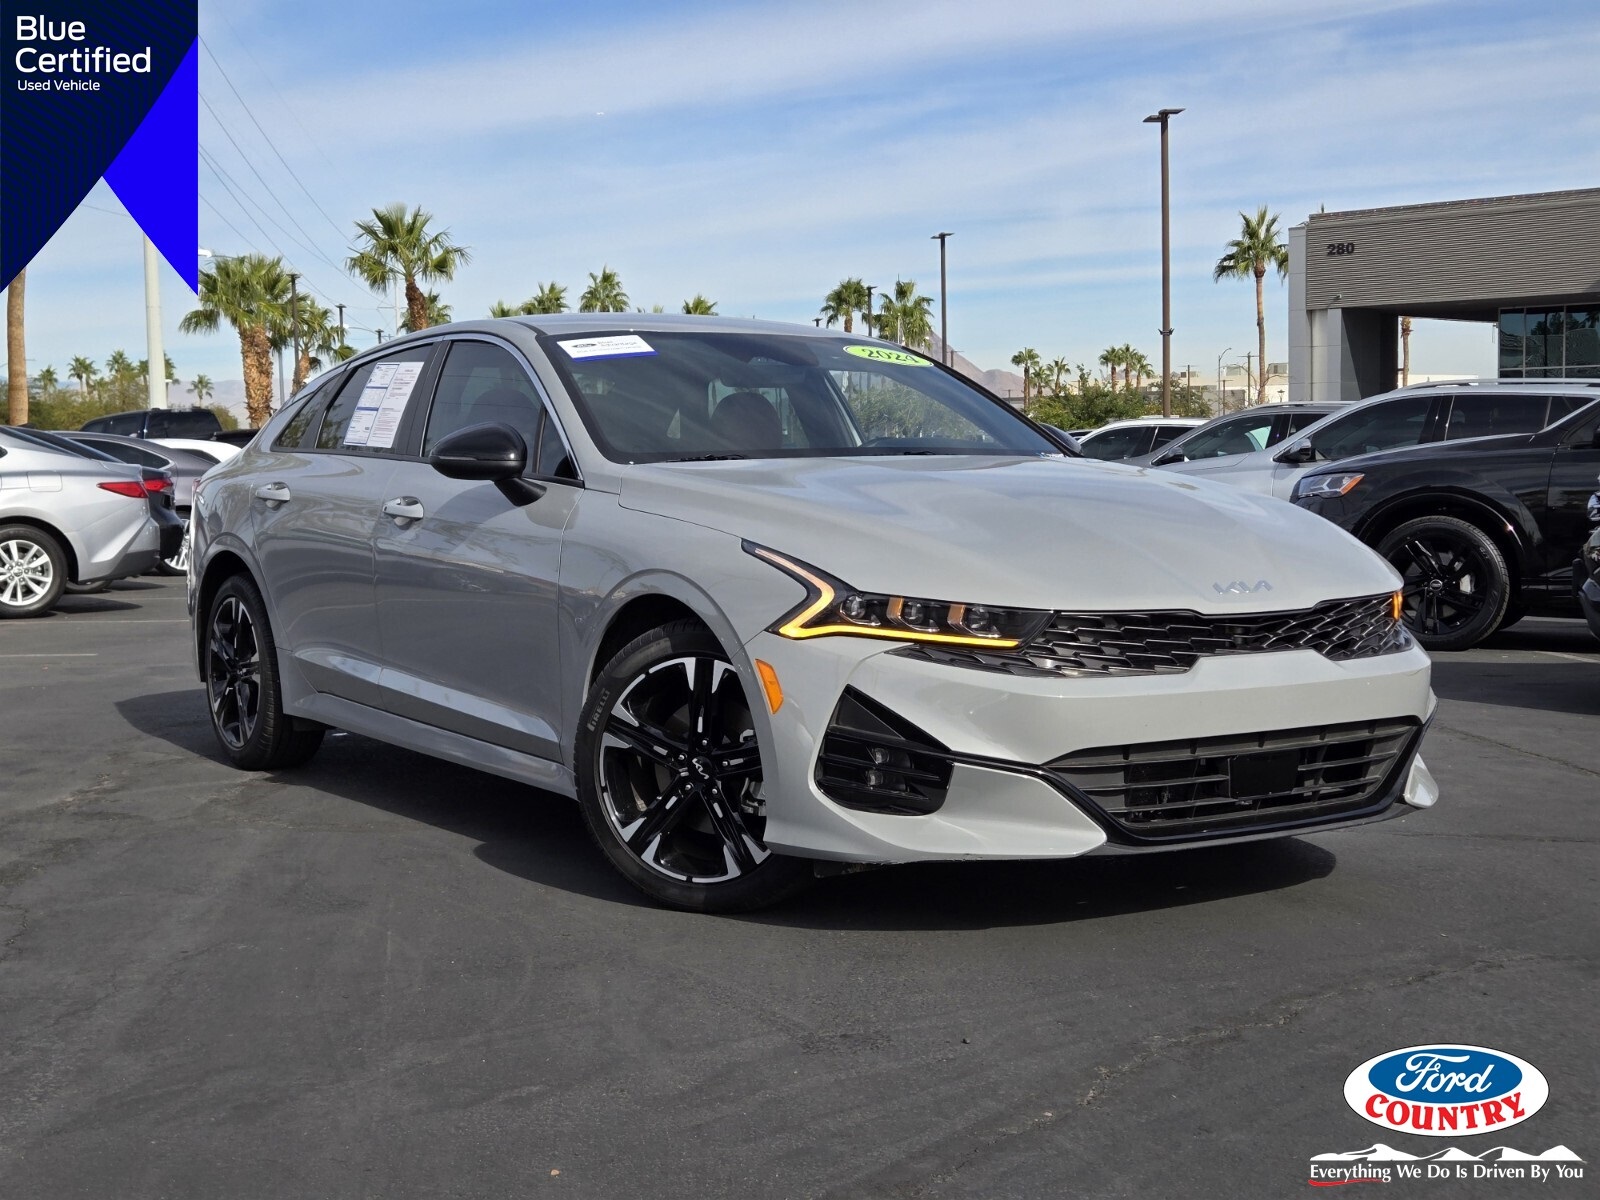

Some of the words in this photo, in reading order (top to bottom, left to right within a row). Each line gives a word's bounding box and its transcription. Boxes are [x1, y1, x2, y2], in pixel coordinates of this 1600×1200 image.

[1327, 243, 1355, 256] 280
[1212, 580, 1274, 595] KIA
[586, 687, 611, 732] PIRELLI
